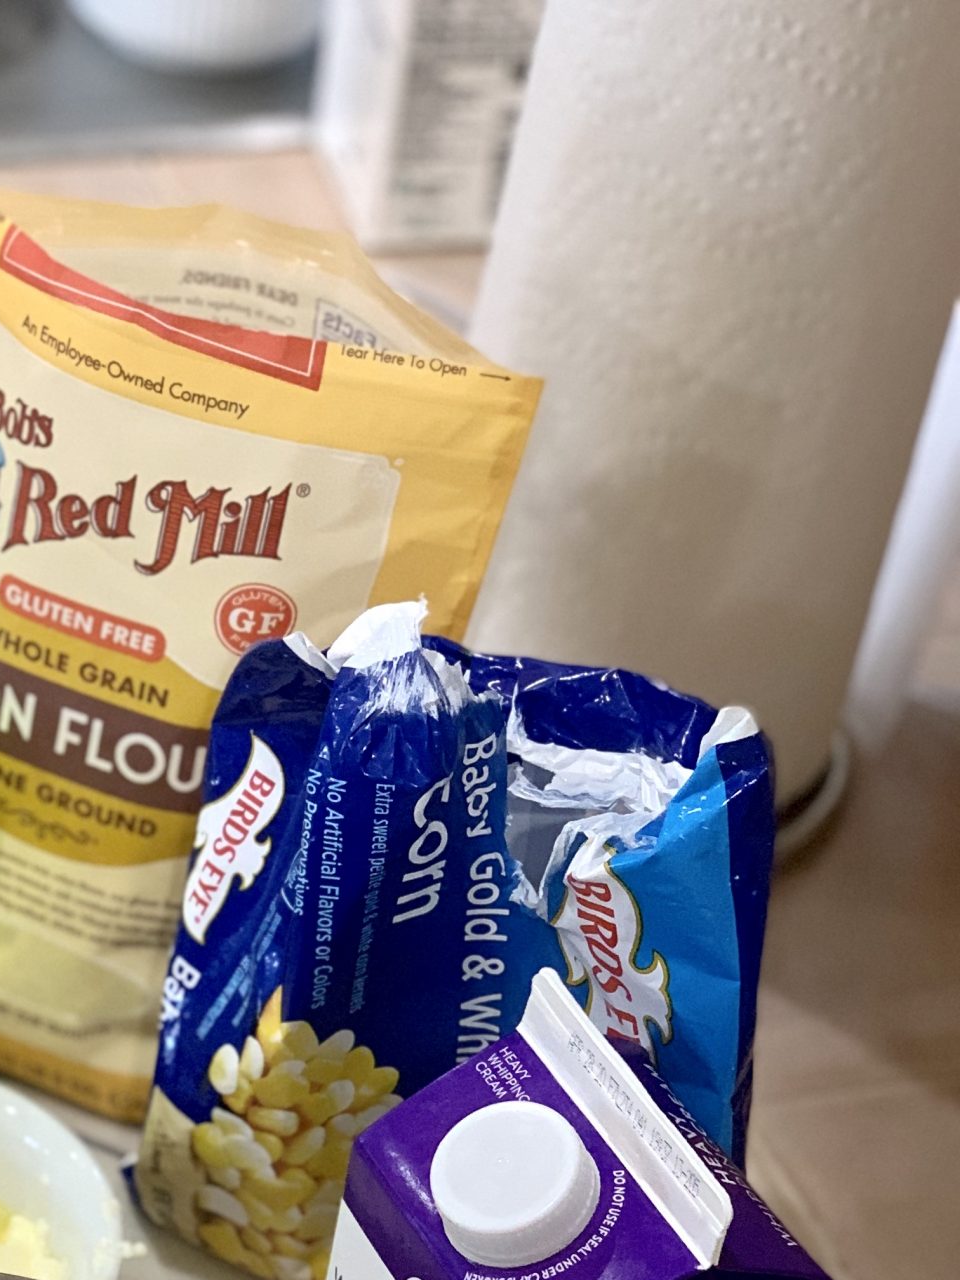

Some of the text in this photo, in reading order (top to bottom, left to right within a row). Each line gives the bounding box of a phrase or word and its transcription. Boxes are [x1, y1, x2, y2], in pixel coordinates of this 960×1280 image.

[21, 314, 251, 419] An Employee-Owned Company
[341, 343, 468, 379] Tear Here To Open
[1, 460, 139, 554] Red
[133, 481, 294, 576] Mill
[4, 583, 158, 657] GLUTEN FREE
[228, 606, 285, 635] GF
[78, 661, 171, 709] GRAIN
[53, 705, 208, 794] FLOU
[304, 768, 323, 796] No
[374, 783, 396, 815] Extra
[460, 731, 498, 839] Baby
[35, 781, 158, 838] GROUND
[212, 769, 277, 865] BIRDS
[370, 818, 390, 855] sweet
[391, 770, 455, 925] Corn
[310, 777, 348, 1011] No Artificial Flavors or Colors
[463, 851, 511, 943] Gold
[566, 871, 633, 1003] BIRDS
[460, 954, 506, 983] &
[475, 1061, 508, 1099] CREAM
[498, 1046, 532, 1080] HEAVY
[667, 1111, 737, 1186] HEAVY
[612, 1169, 626, 1185] DO
[611, 1187, 626, 1208] NOT
[598, 1227, 611, 1238] IF
[602, 1207, 622, 1228] USE
[577, 1233, 603, 1257] SEAL
[540, 1253, 581, 1280] UNDER
